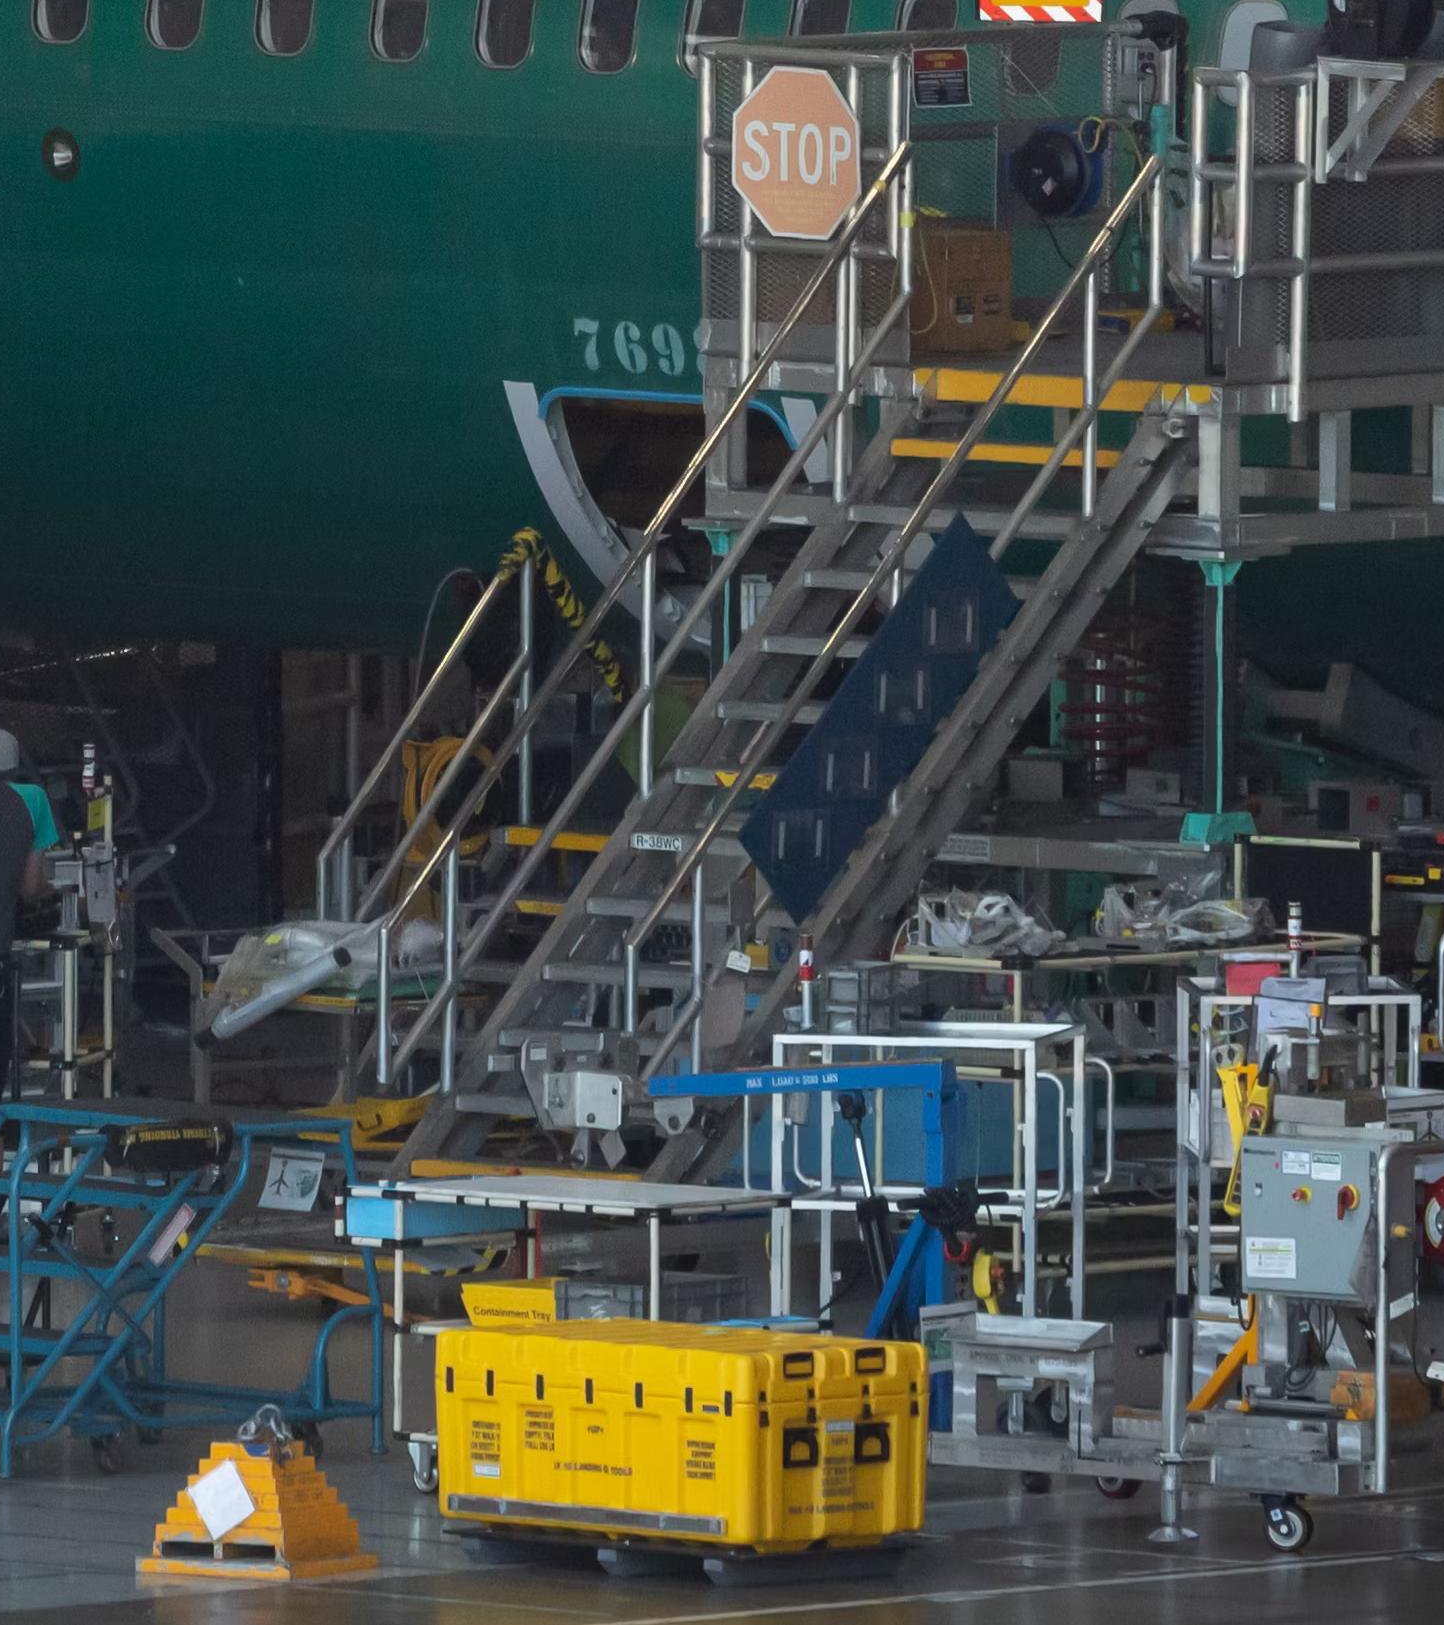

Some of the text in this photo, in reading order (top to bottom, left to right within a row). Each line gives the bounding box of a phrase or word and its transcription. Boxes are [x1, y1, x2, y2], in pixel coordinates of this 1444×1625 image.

[742, 119, 851, 185] STOP
[636, 835, 680, 851] R-38WC
[746, 1077, 763, 1089] MAX
[771, 1076, 794, 1087] LOAD
[473, 1306, 551, 1323] Containment Tray
